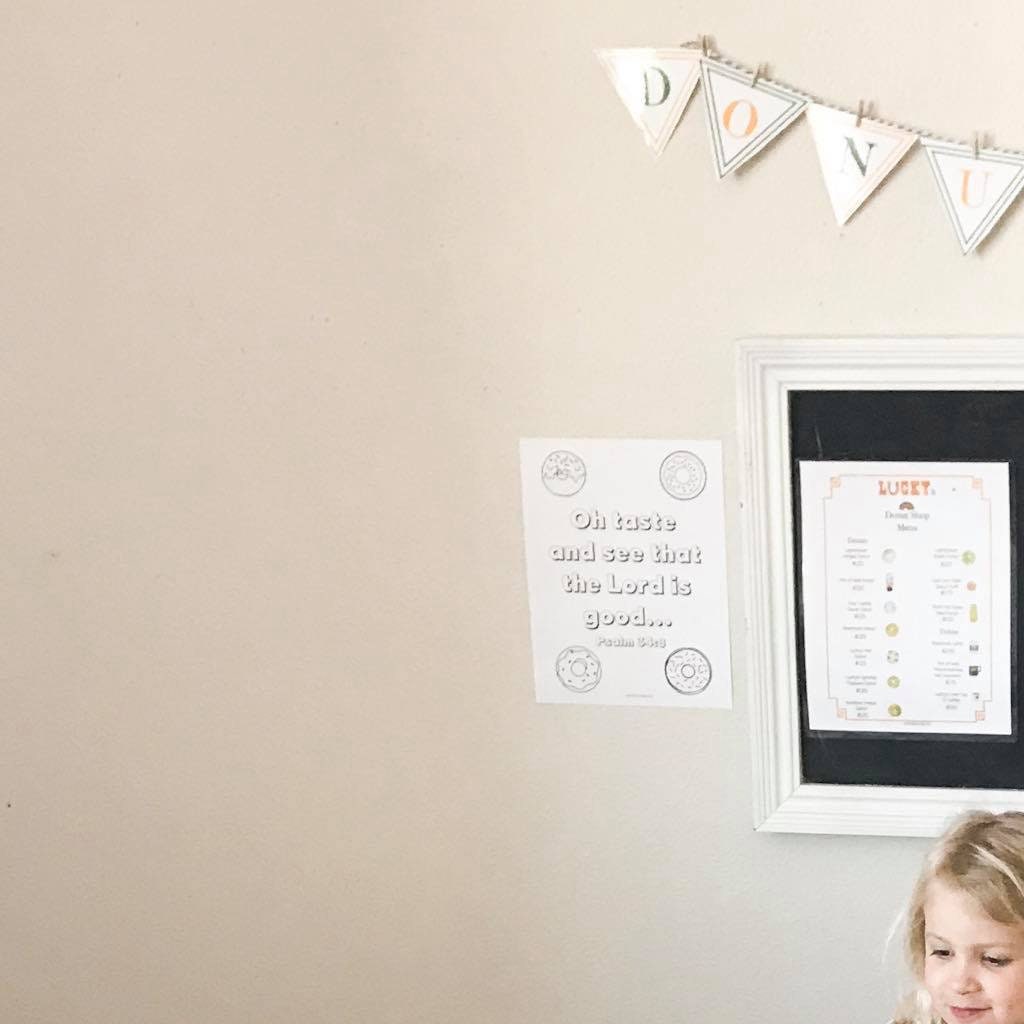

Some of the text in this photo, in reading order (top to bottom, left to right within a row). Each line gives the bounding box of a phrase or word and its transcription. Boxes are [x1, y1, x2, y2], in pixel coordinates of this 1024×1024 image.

[572, 510, 677, 532] Oh taste
[549, 543, 703, 564] and see that
[562, 574, 692, 596] the Lord is
[583, 608, 673, 630] good...
[598, 636, 635, 648] Psalm
